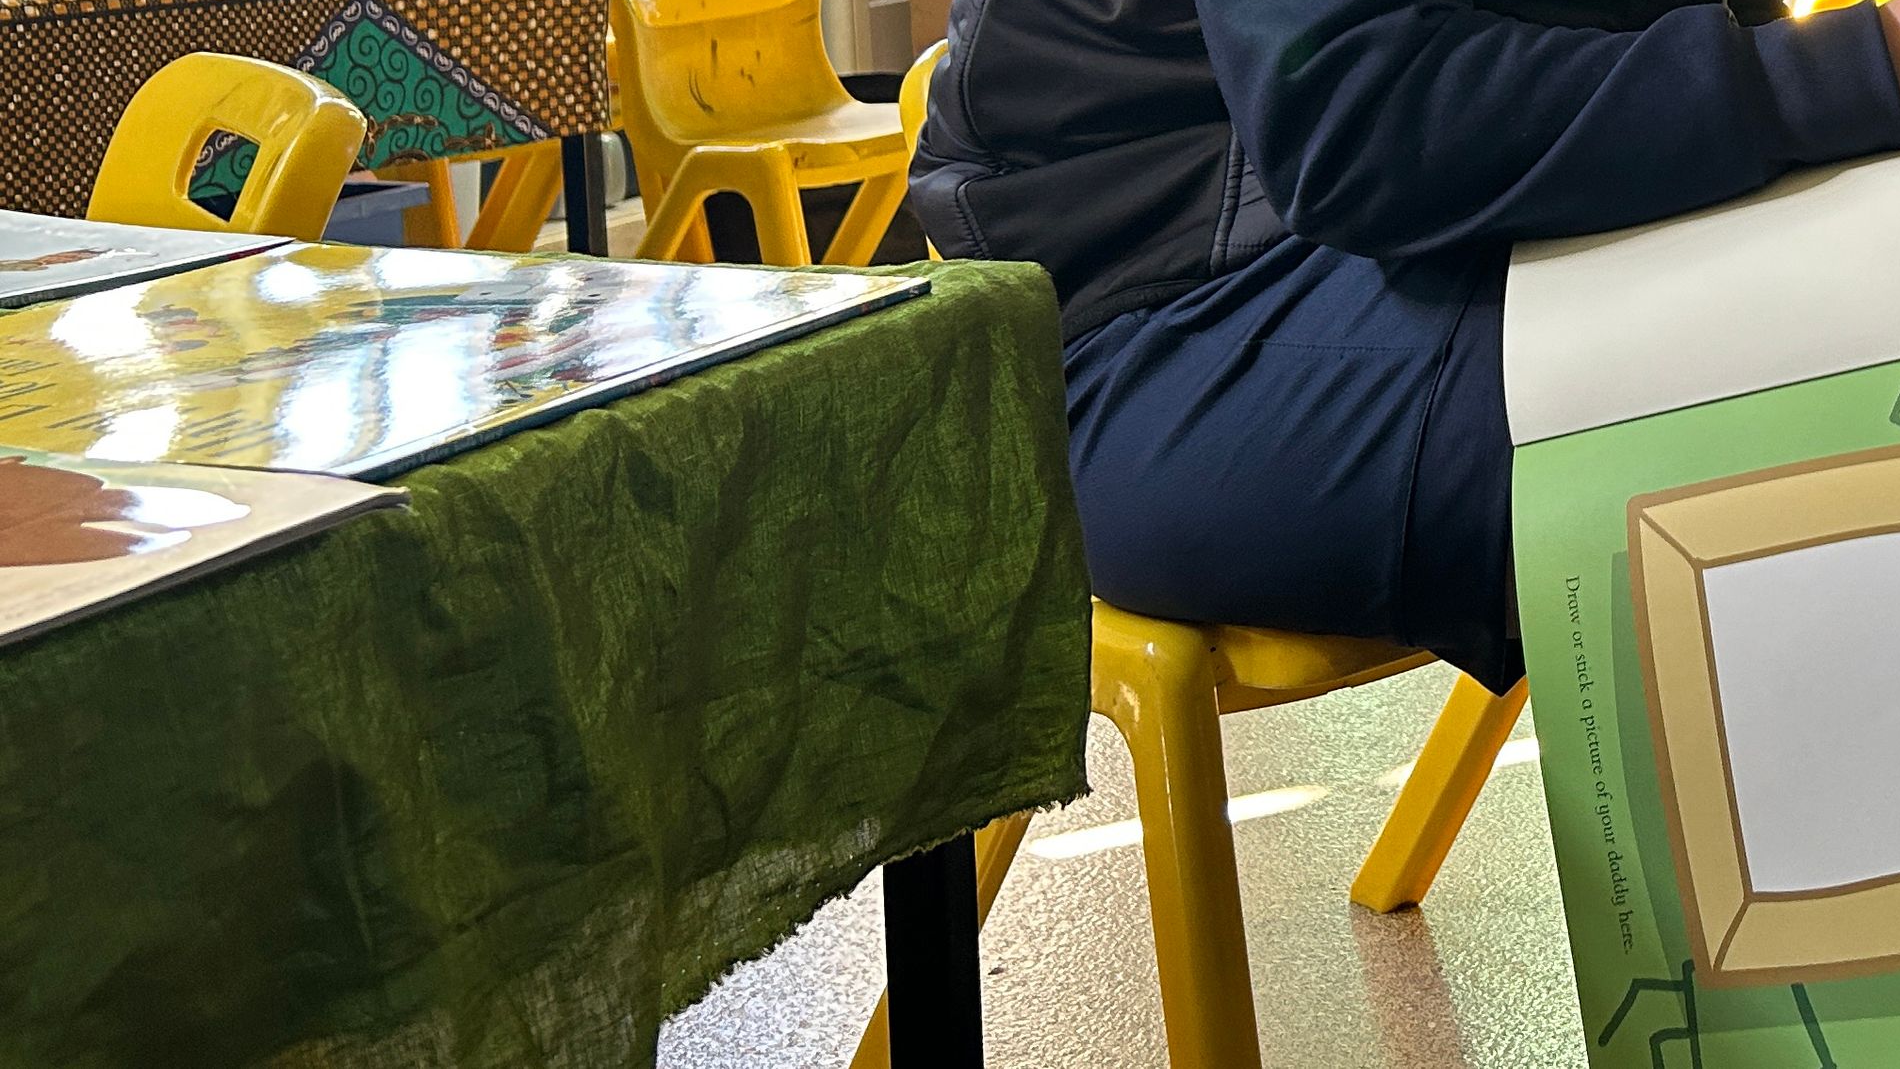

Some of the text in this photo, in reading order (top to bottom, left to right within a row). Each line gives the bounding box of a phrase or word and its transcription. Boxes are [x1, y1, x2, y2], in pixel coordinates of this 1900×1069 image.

[1566, 575, 1634, 955] Draw or stick a picture of your daddy here.
